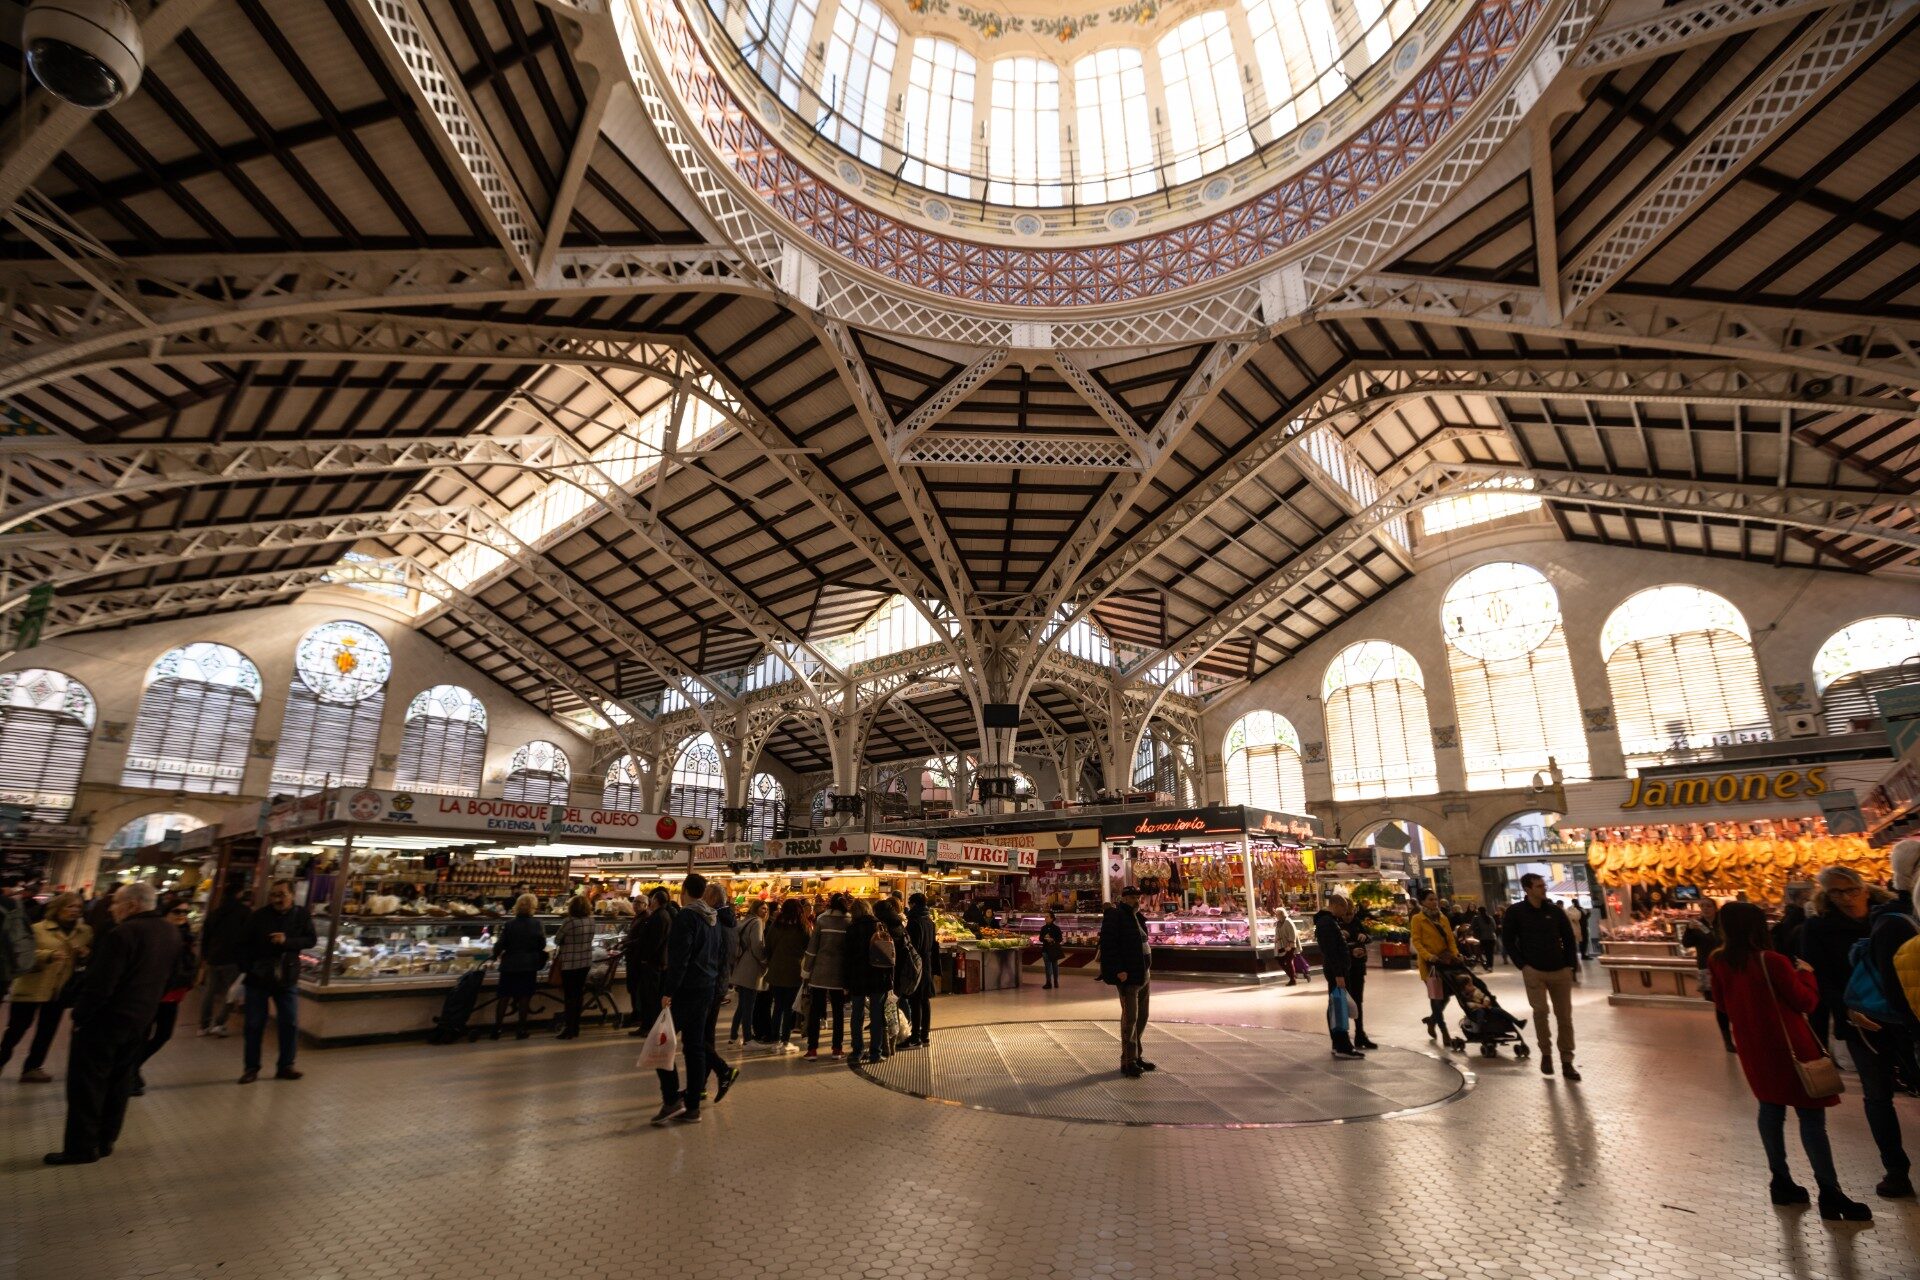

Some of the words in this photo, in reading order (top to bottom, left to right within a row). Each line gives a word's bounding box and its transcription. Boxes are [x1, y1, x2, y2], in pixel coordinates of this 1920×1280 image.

[1619, 766, 1829, 809] Jamones
[439, 798, 461, 814] LA
[467, 800, 548, 820] BOUTIQUE
[561, 808, 583, 823] DEL
[591, 811, 639, 827] QUESO
[487, 818, 536, 831] EXTENSA
[542, 822, 597, 835] VAIACION
[697, 845, 728, 860] IRGINIA
[785, 839, 823, 856] FRESAS
[872, 837, 926, 856] VIRGINIA
[963, 846, 1035, 866] VIRGIIA
